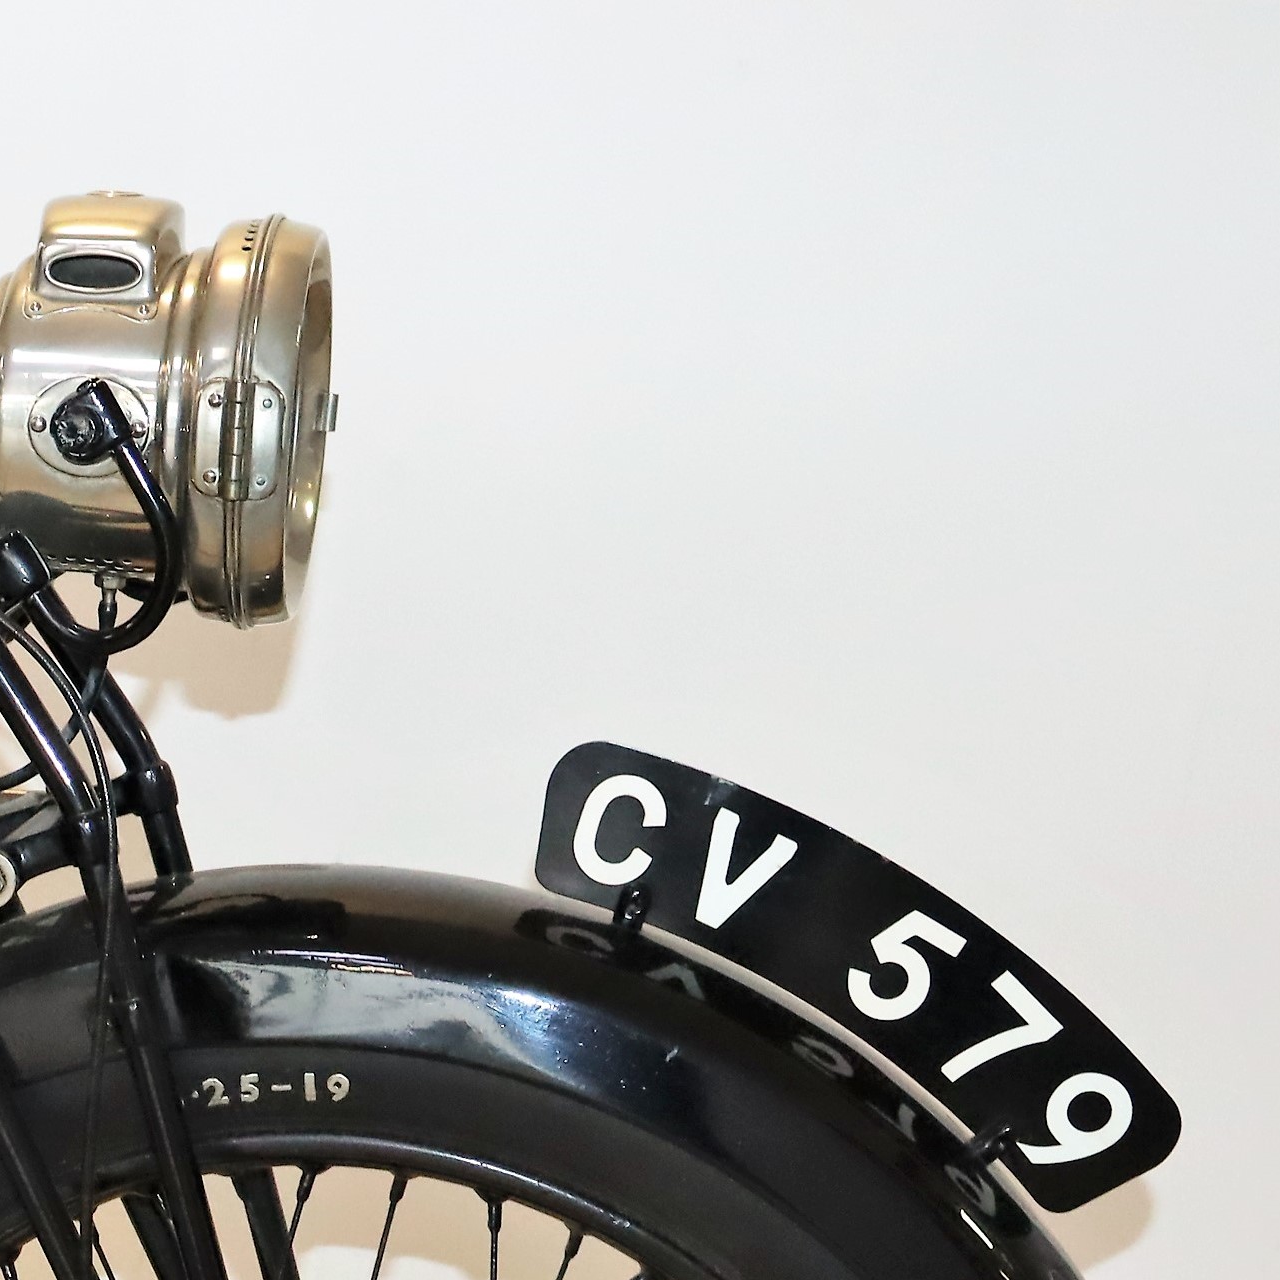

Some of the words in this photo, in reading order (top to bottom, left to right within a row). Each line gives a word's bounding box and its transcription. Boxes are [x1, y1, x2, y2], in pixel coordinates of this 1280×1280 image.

[572, 773, 798, 930] CV
[847, 909, 1134, 1165] 579
[180, 1072, 351, 1108] .25-19
